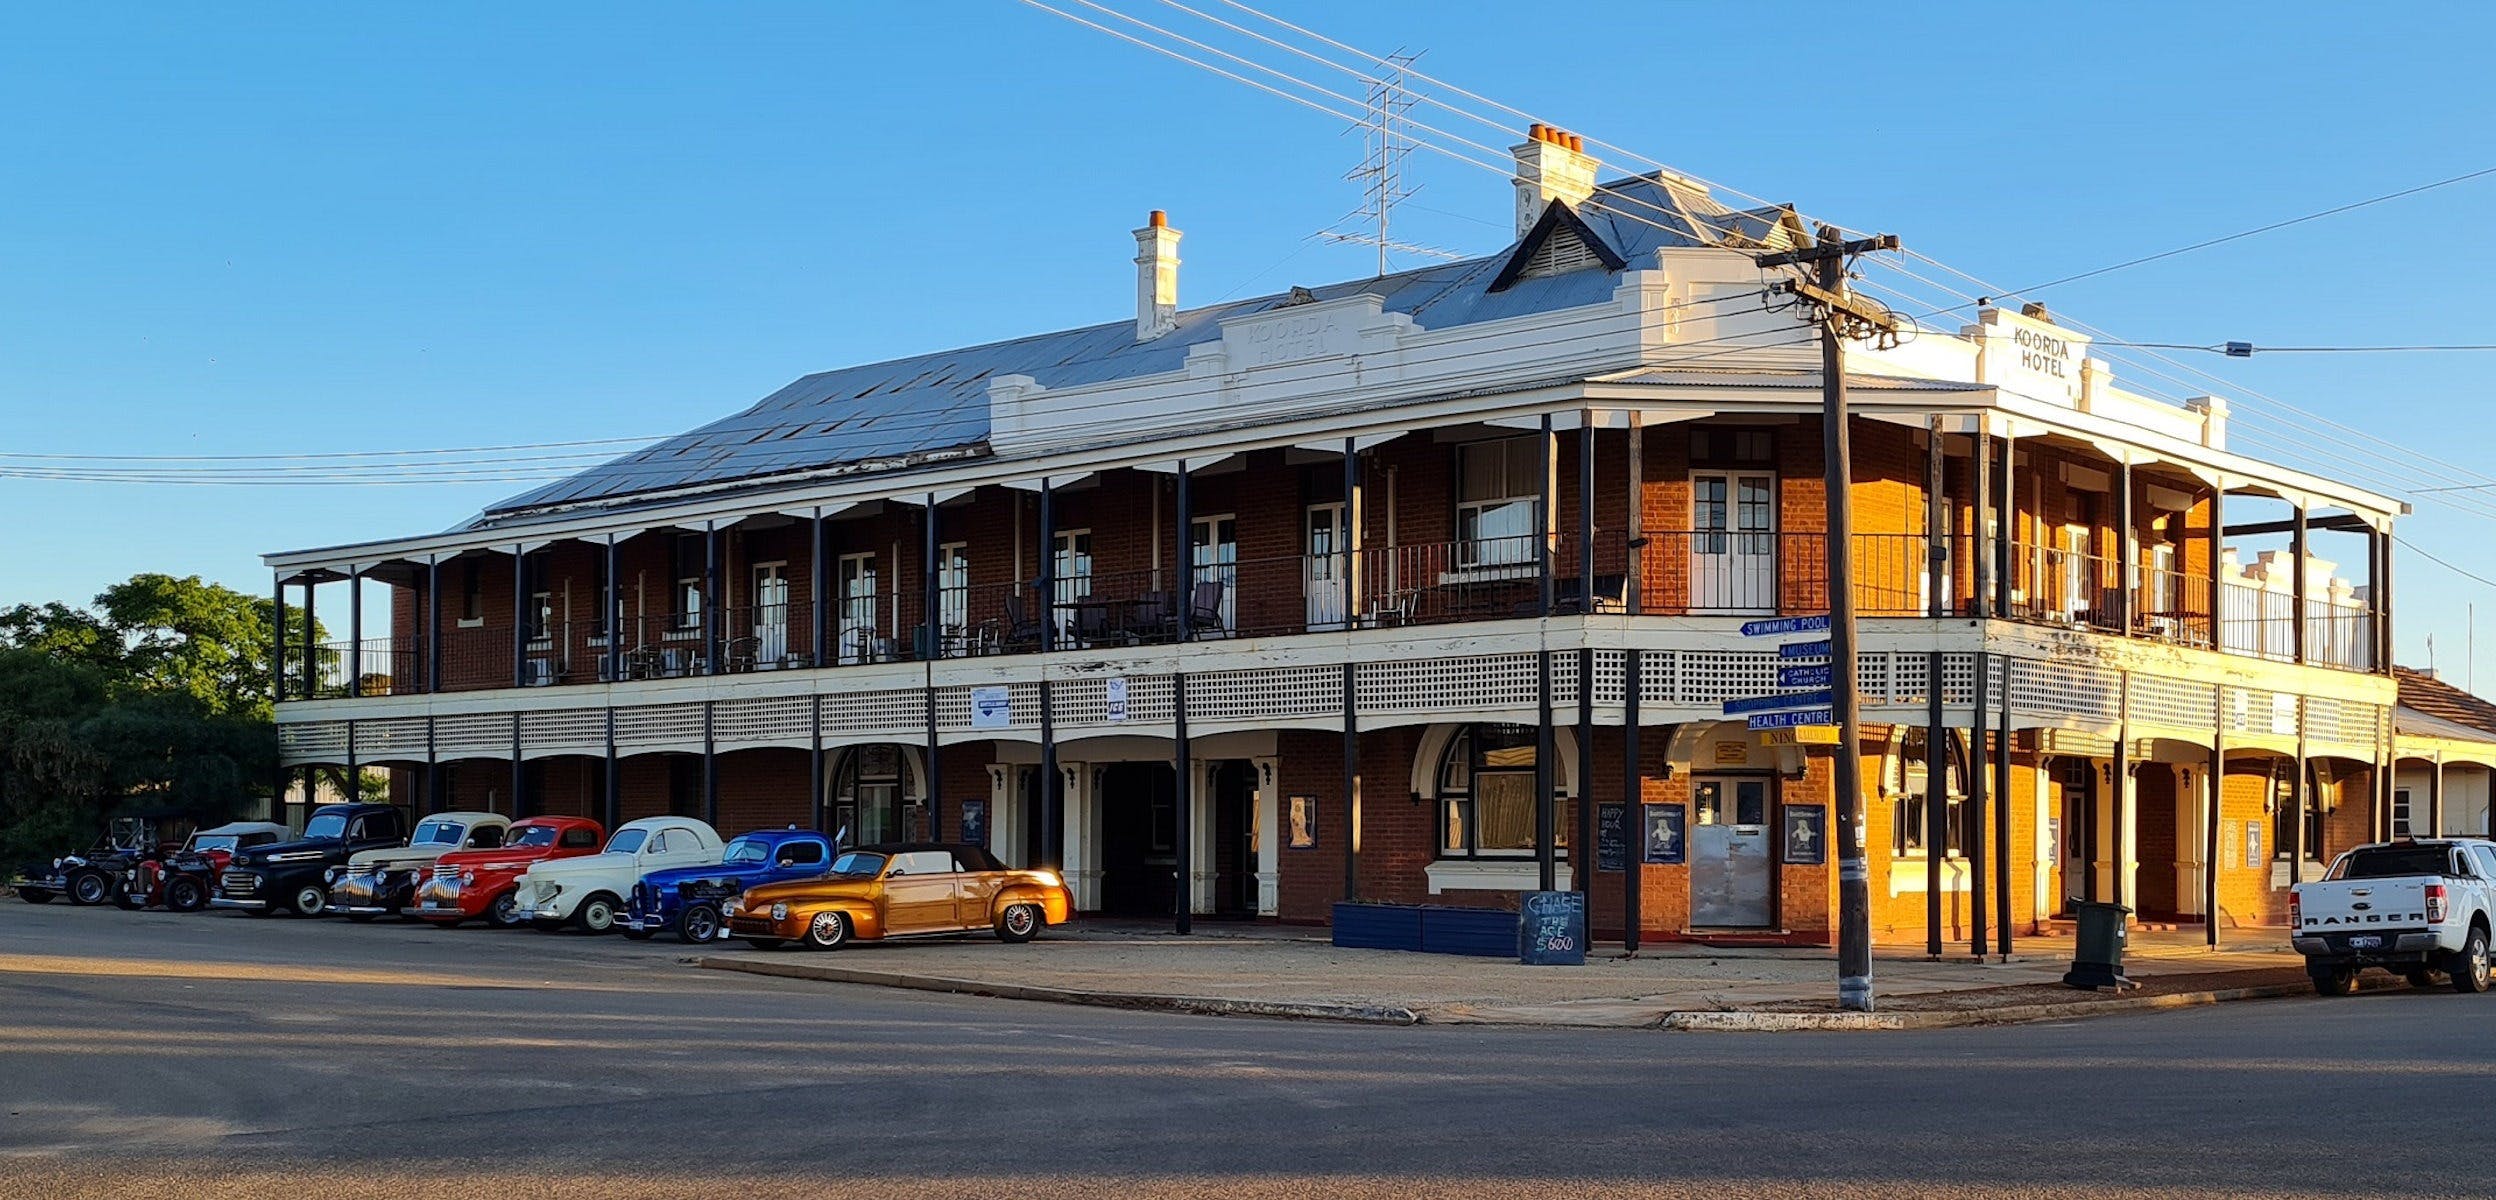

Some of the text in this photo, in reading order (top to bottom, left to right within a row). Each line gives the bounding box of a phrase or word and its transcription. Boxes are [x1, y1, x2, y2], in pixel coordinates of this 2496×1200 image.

[1250, 315, 1339, 344] KOORDA
[1259, 335, 1329, 363] HOTEL
[2015, 327, 2069, 360] KOORDA
[2022, 350, 2065, 379] HOTEL
[1747, 616, 1828, 635] SWIMMING POOL
[1787, 642, 1830, 657] MUSEUM
[1787, 667, 1830, 677] CATHOLIC
[1791, 675, 1827, 684] CHURCH
[1110, 702, 1124, 712] ICE
[1735, 693, 1819, 711] SHOPPING CENTRE
[1750, 711, 1830, 728] HEALTH CENTRE
[1528, 895, 1582, 914] CHASE
[1541, 916, 1568, 927] THE
[2305, 913, 2424, 926] RANGER
